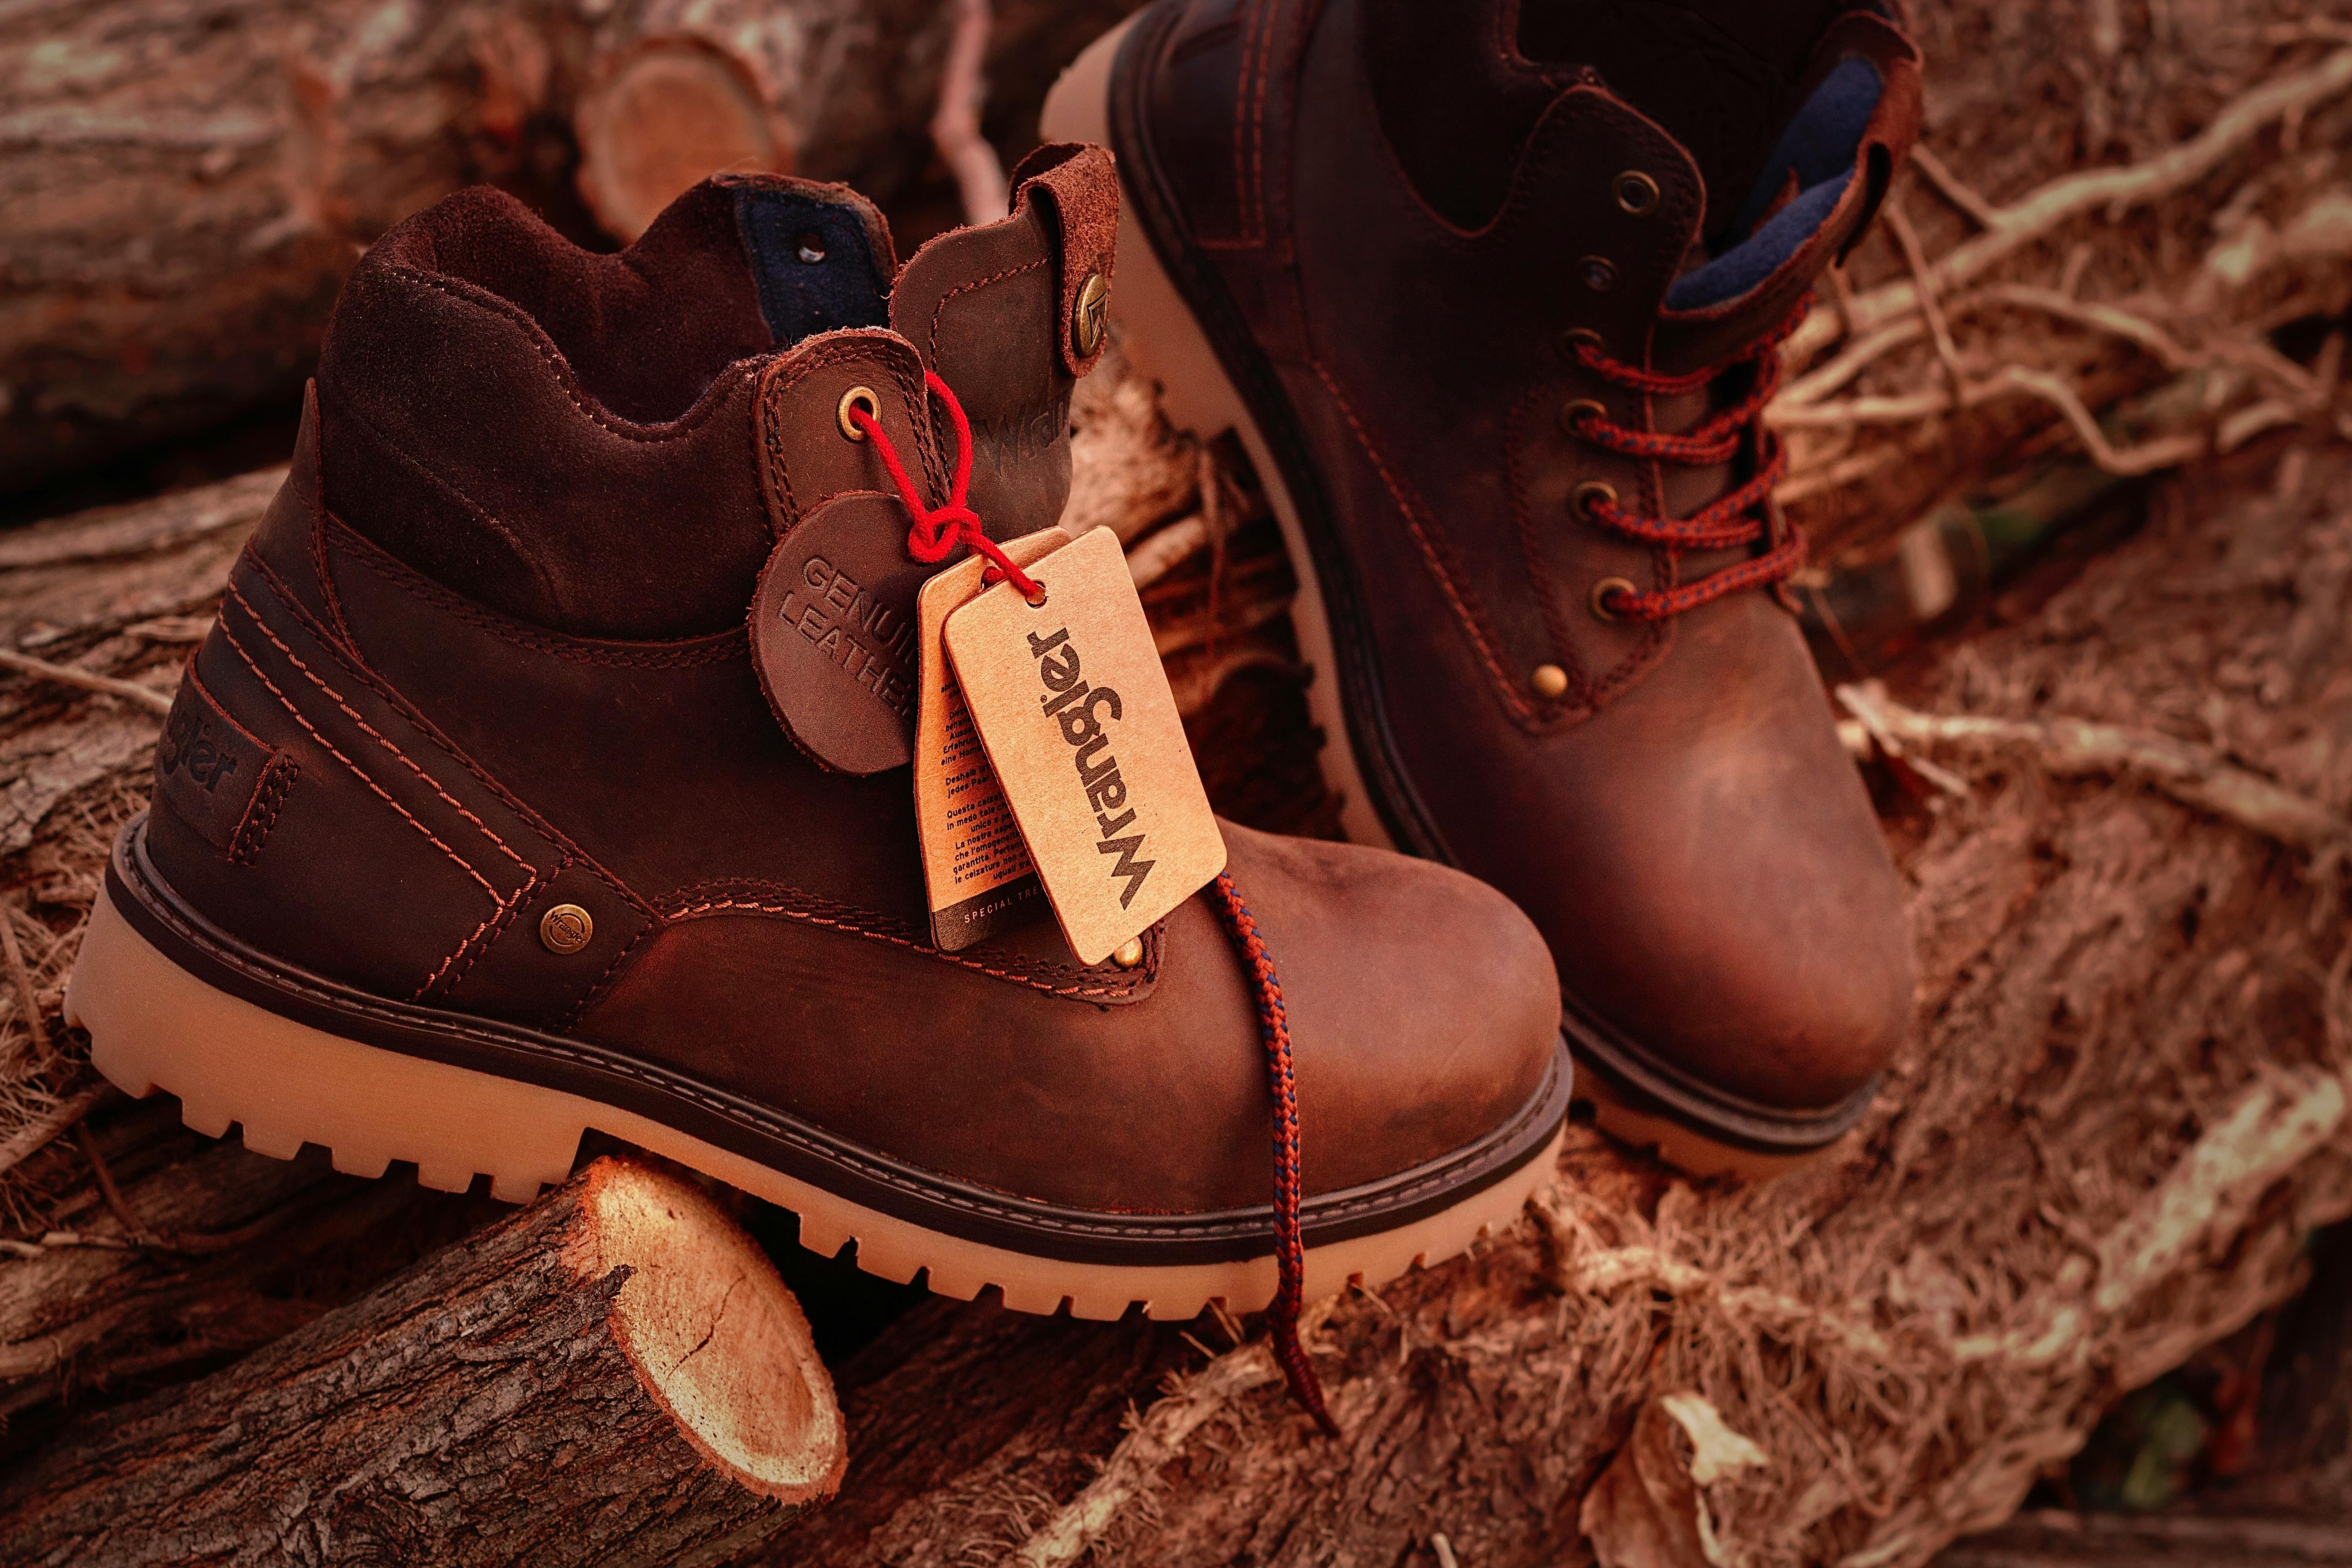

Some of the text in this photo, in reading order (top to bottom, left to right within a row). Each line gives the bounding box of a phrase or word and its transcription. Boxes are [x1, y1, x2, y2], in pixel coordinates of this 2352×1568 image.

[778, 592, 916, 717] LEATHE
[941, 755, 956, 766] eine
[1026, 627, 1156, 910] Wrangler
[946, 769, 976, 786] Deshalb
[948, 783, 969, 799] jedes
[947, 803, 975, 818] Questa
[947, 822, 954, 830] in
[980, 807, 995, 817] tale
[970, 819, 992, 833] unico
[955, 841, 965, 850] La
[967, 831, 992, 846] nostra
[955, 850, 969, 861] che
[955, 876, 962, 884] le
[1003, 854, 1017, 864] non
[993, 863, 1017, 880] uguali
[965, 885, 1043, 923] SPECIAL TRE
[550, 910, 588, 944] Wrangler
